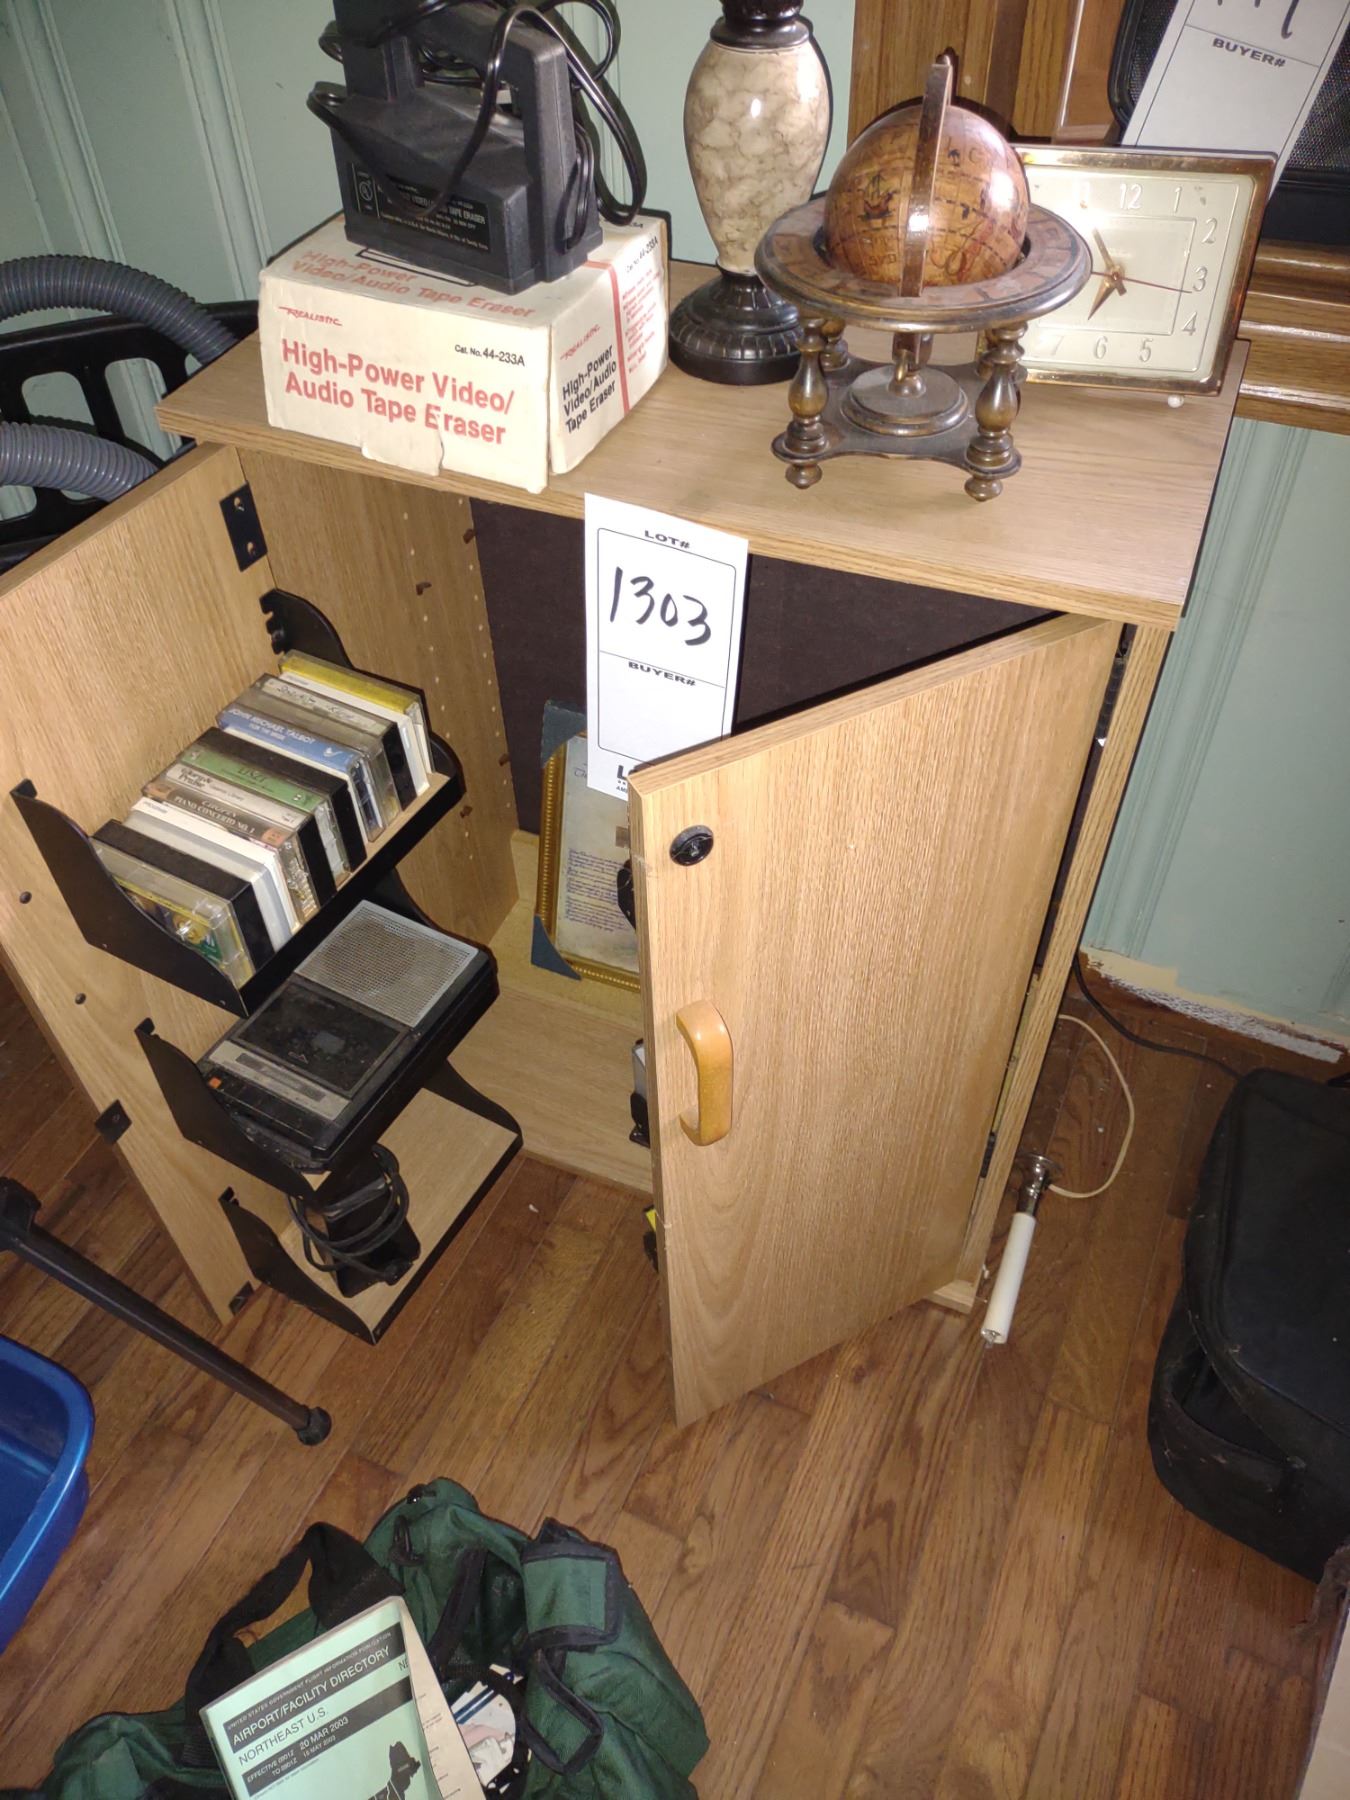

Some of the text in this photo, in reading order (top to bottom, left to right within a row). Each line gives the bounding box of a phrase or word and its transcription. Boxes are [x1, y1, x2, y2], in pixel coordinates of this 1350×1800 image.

[1212, 37, 1286, 68] BUYER#
[1120, 183, 1143, 210] 12
[1172, 186, 1182, 214] 1
[1201, 217, 1218, 244] 2
[302, 250, 418, 282] High-Power
[1192, 265, 1208, 292] 3
[292, 260, 536, 317] Video/Audio Tape Eraser
[1181, 311, 1198, 336] 4
[454, 344, 526, 367] Cat. No. 44-233A
[1093, 335, 1109, 359] 6
[1139, 337, 1154, 362] 5
[281, 338, 515, 415] High-Power Video/
[562, 344, 614, 401] High-Power
[563, 360, 617, 418] Video/Audio
[285, 370, 507, 445] Audio Tape Eraser
[565, 380, 617, 434] Tape Eraser
[644, 529, 690, 549] LOT#
[609, 566, 711, 646] 1303
[627, 661, 697, 687] BUYER#
[196, 802, 237, 826] CONCERTO
[232, 1646, 391, 1746] AIRPORT/FACILITY DIRECTORY
[238, 1706, 329, 1767] NORTHEAST U.S.
[246, 1759, 278, 1783] EFFECTIVE
[299, 1740, 310, 1751] 20
[310, 1727, 330, 1744] MAR
[329, 1716, 349, 1733] 2003
[271, 1767, 281, 1777] TO
